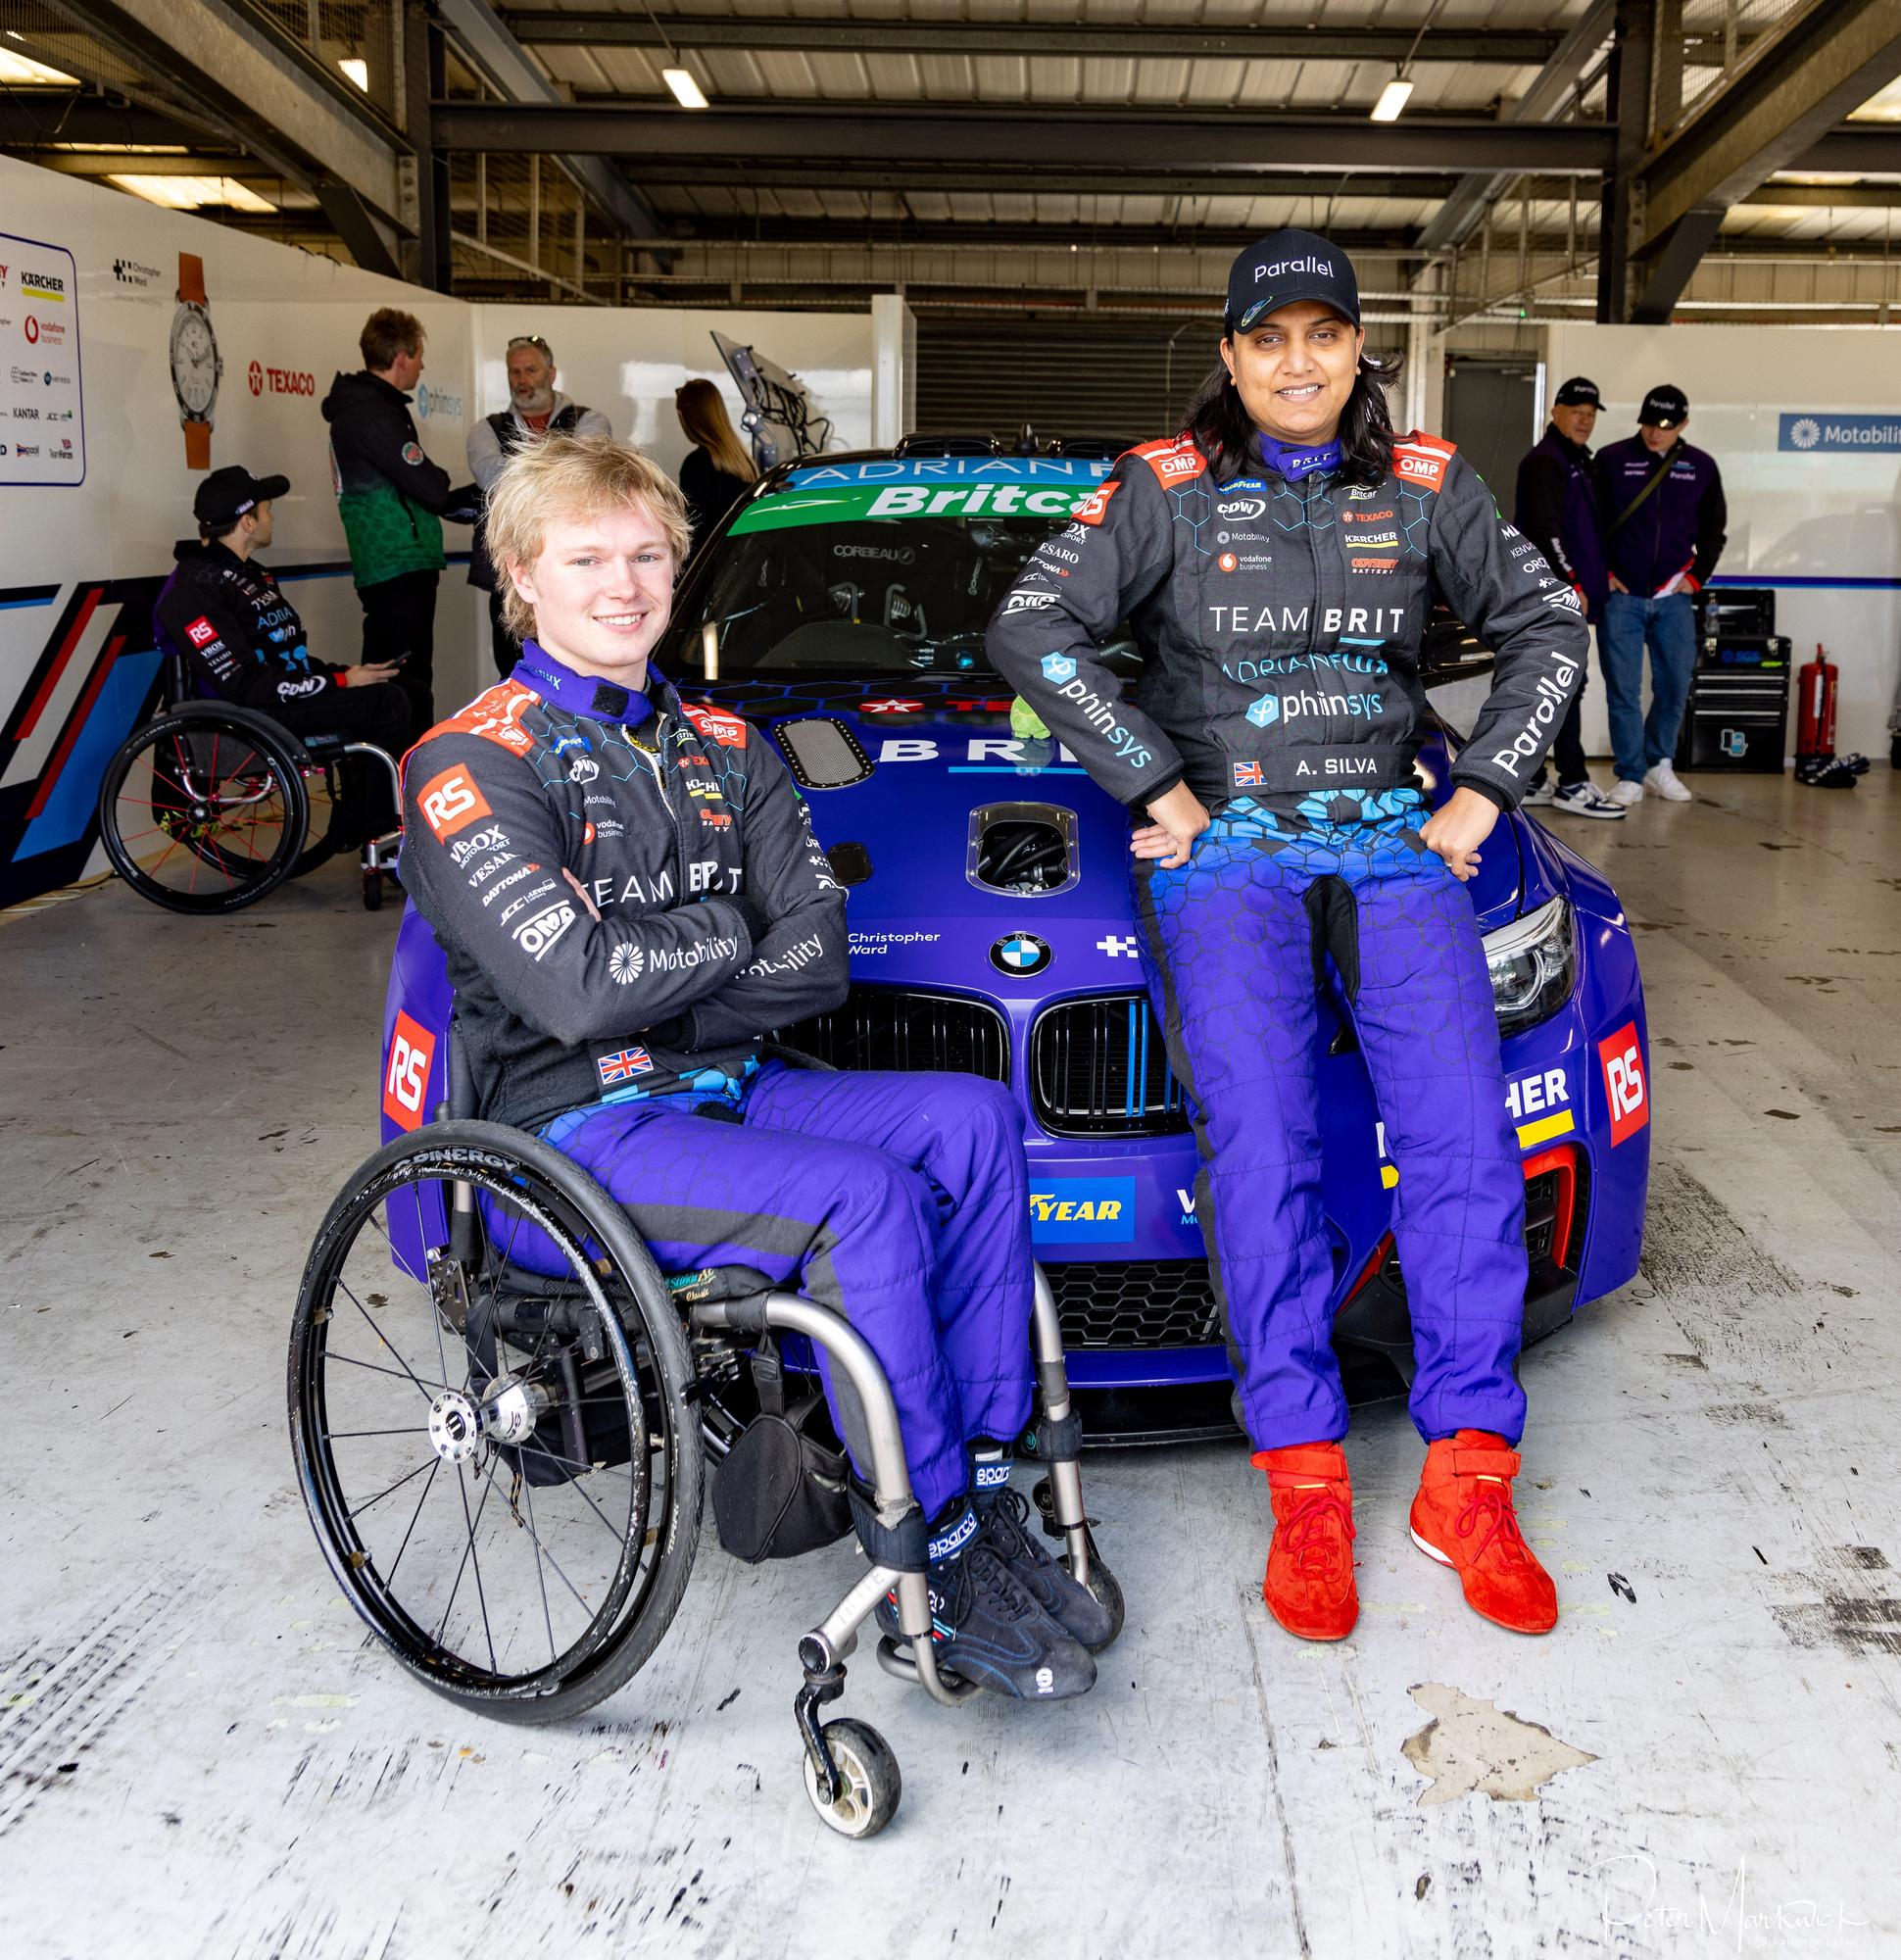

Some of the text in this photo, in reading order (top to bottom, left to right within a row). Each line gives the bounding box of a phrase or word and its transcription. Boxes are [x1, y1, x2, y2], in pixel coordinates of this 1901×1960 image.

[1254, 256, 1335, 283] Parallel
[266, 368, 316, 397] TEXACO
[13, 407, 39, 420] KANTAR
[428, 388, 462, 420] phinsys
[1649, 398, 1676, 411] Parallel
[1160, 457, 1196, 473] OMP
[1292, 452, 1332, 469] BRIT
[1400, 459, 1439, 477] OMP
[1670, 470, 1696, 480] Parallel
[1351, 488, 1378, 499] Britcar
[1217, 499, 1259, 516] CDW
[1355, 510, 1393, 522] TEXACO
[1231, 532, 1270, 544] Motability
[833, 545, 899, 562] CORBEAU
[1239, 555, 1273, 564] vodafone
[1351, 558, 1399, 568] ODYSSEY
[1208, 607, 1405, 633] TEAM BRIT
[189, 621, 214, 644] RS
[200, 639, 226, 658] VBOX
[277, 676, 319, 699] CDW
[1282, 690, 1385, 724] phinsys
[1491, 651, 1580, 778] Parallel
[1056, 678, 1152, 769] phinsys
[1295, 758, 1378, 776] A. SILVA
[424, 776, 476, 832] RS
[450, 824, 508, 863] VBOX
[481, 866, 532, 907] DAYTONA
[501, 897, 525, 927] JCC
[519, 906, 576, 954] OMP
[848, 932, 941, 945] Christopher
[996, 933, 1048, 948] BMW
[650, 936, 739, 973] Motability
[849, 944, 888, 956] Ward
[388, 1034, 427, 1112] RS
[1606, 1045, 1643, 1122] RS
[1037, 1200, 1122, 1221] YEAR
[929, 1512, 978, 1558] sparco
